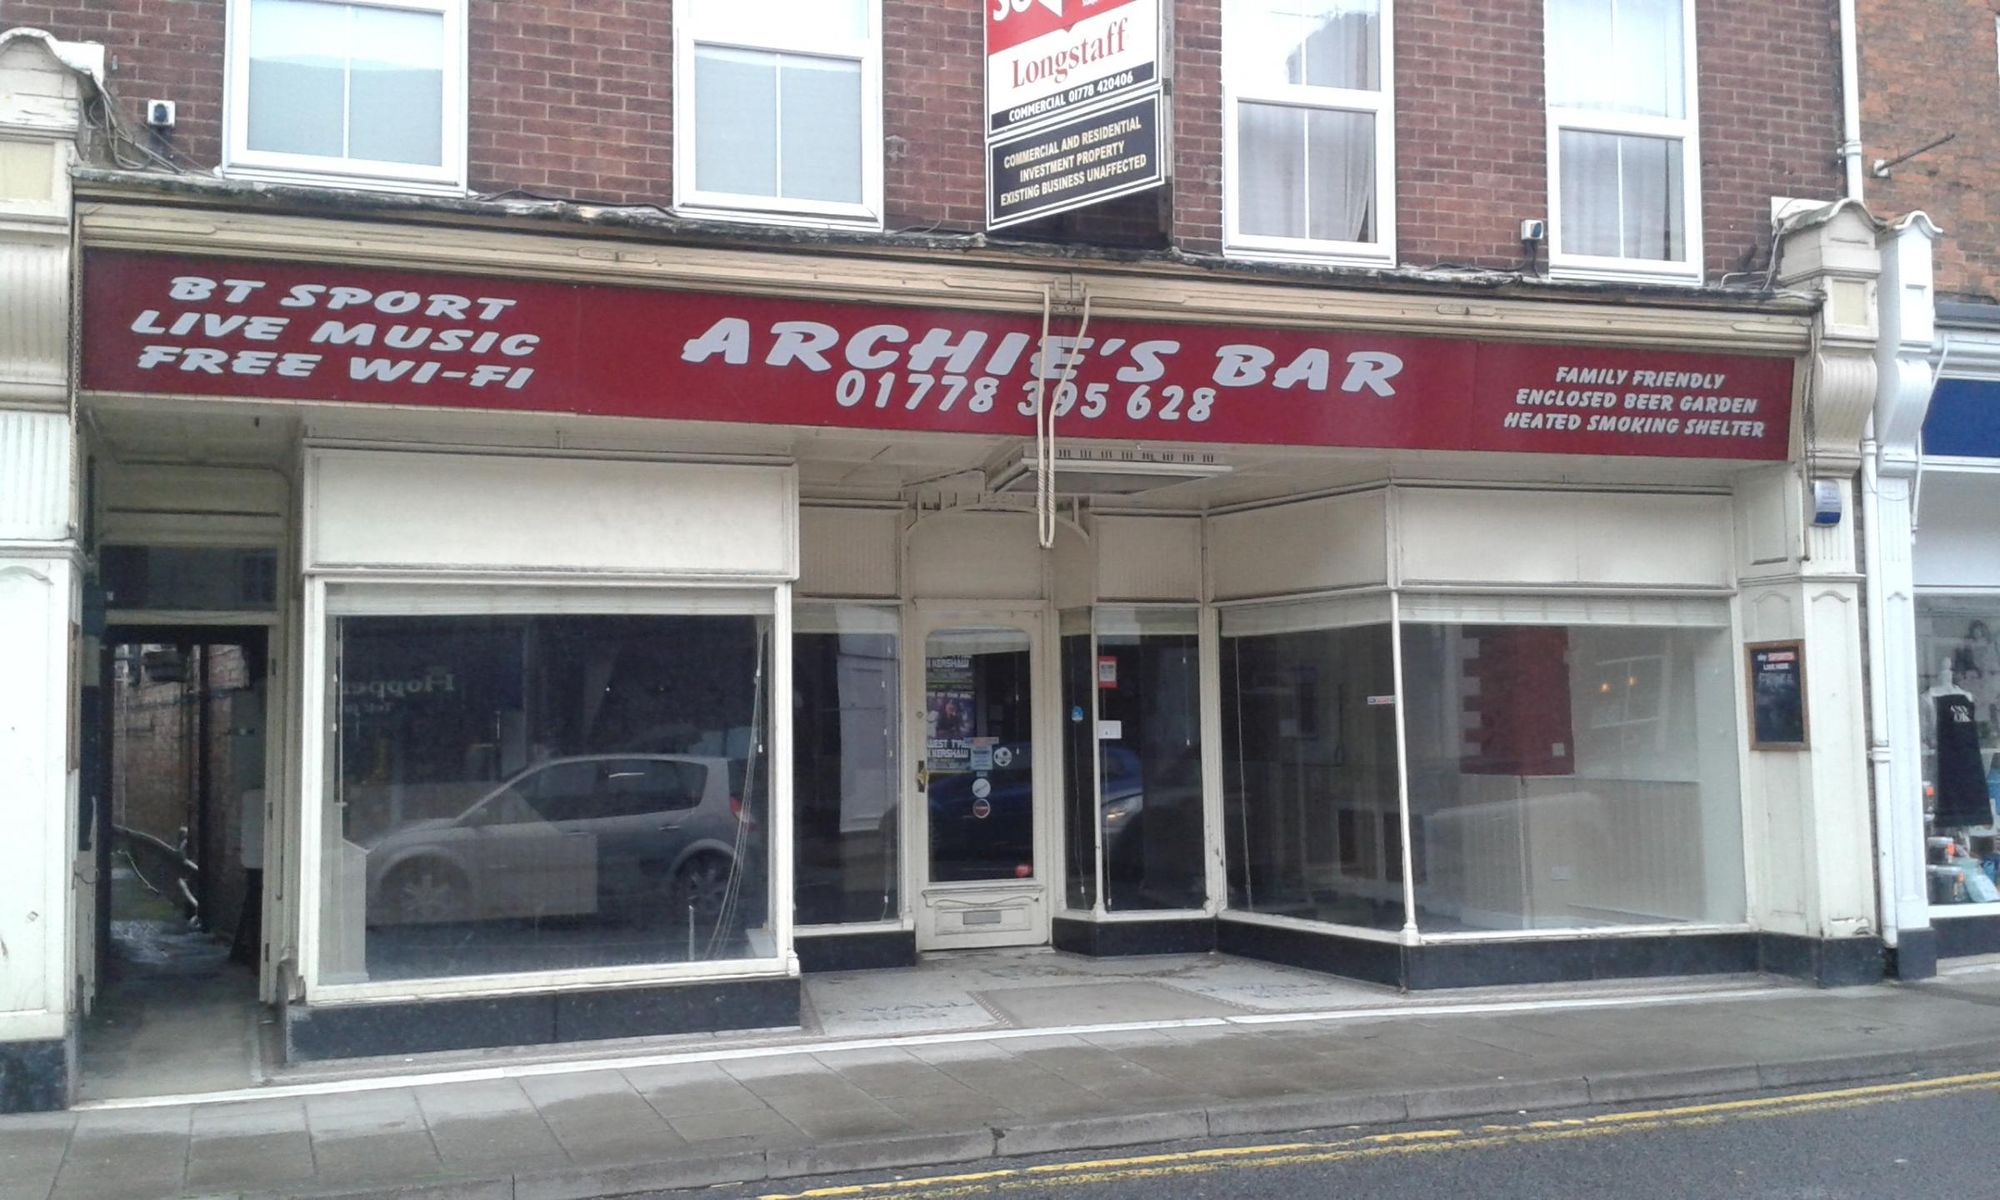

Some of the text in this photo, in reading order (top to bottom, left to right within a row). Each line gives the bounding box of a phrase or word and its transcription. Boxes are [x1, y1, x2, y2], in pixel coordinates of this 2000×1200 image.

[1012, 17, 1128, 88] Longstaff
[1009, 70, 1133, 122] COMMERCIAL 01778 420406
[1004, 116, 1141, 169] COMMERCIAL AND RESIDENTIAL
[1020, 140, 1125, 183] INVESTMENT PROPERTY
[1001, 154, 1146, 206] EXISTING BUSINESS UNAFFECTED
[169, 276, 516, 321] BT SPORT
[131, 310, 540, 356] LIVE MUSIC
[138, 345, 535, 389] FREE WI-FI
[681, 317, 1403, 396] ARCHIE'S BAR
[1555, 367, 1725, 389] FAMILY FRIENDLY
[836, 370, 1000, 413] 01778
[1126, 384, 1216, 422] 628
[1516, 388, 1758, 414] ENCLOSED BEER GARDEN
[1504, 412, 1765, 438] HEATED SMOKING SHELTER
